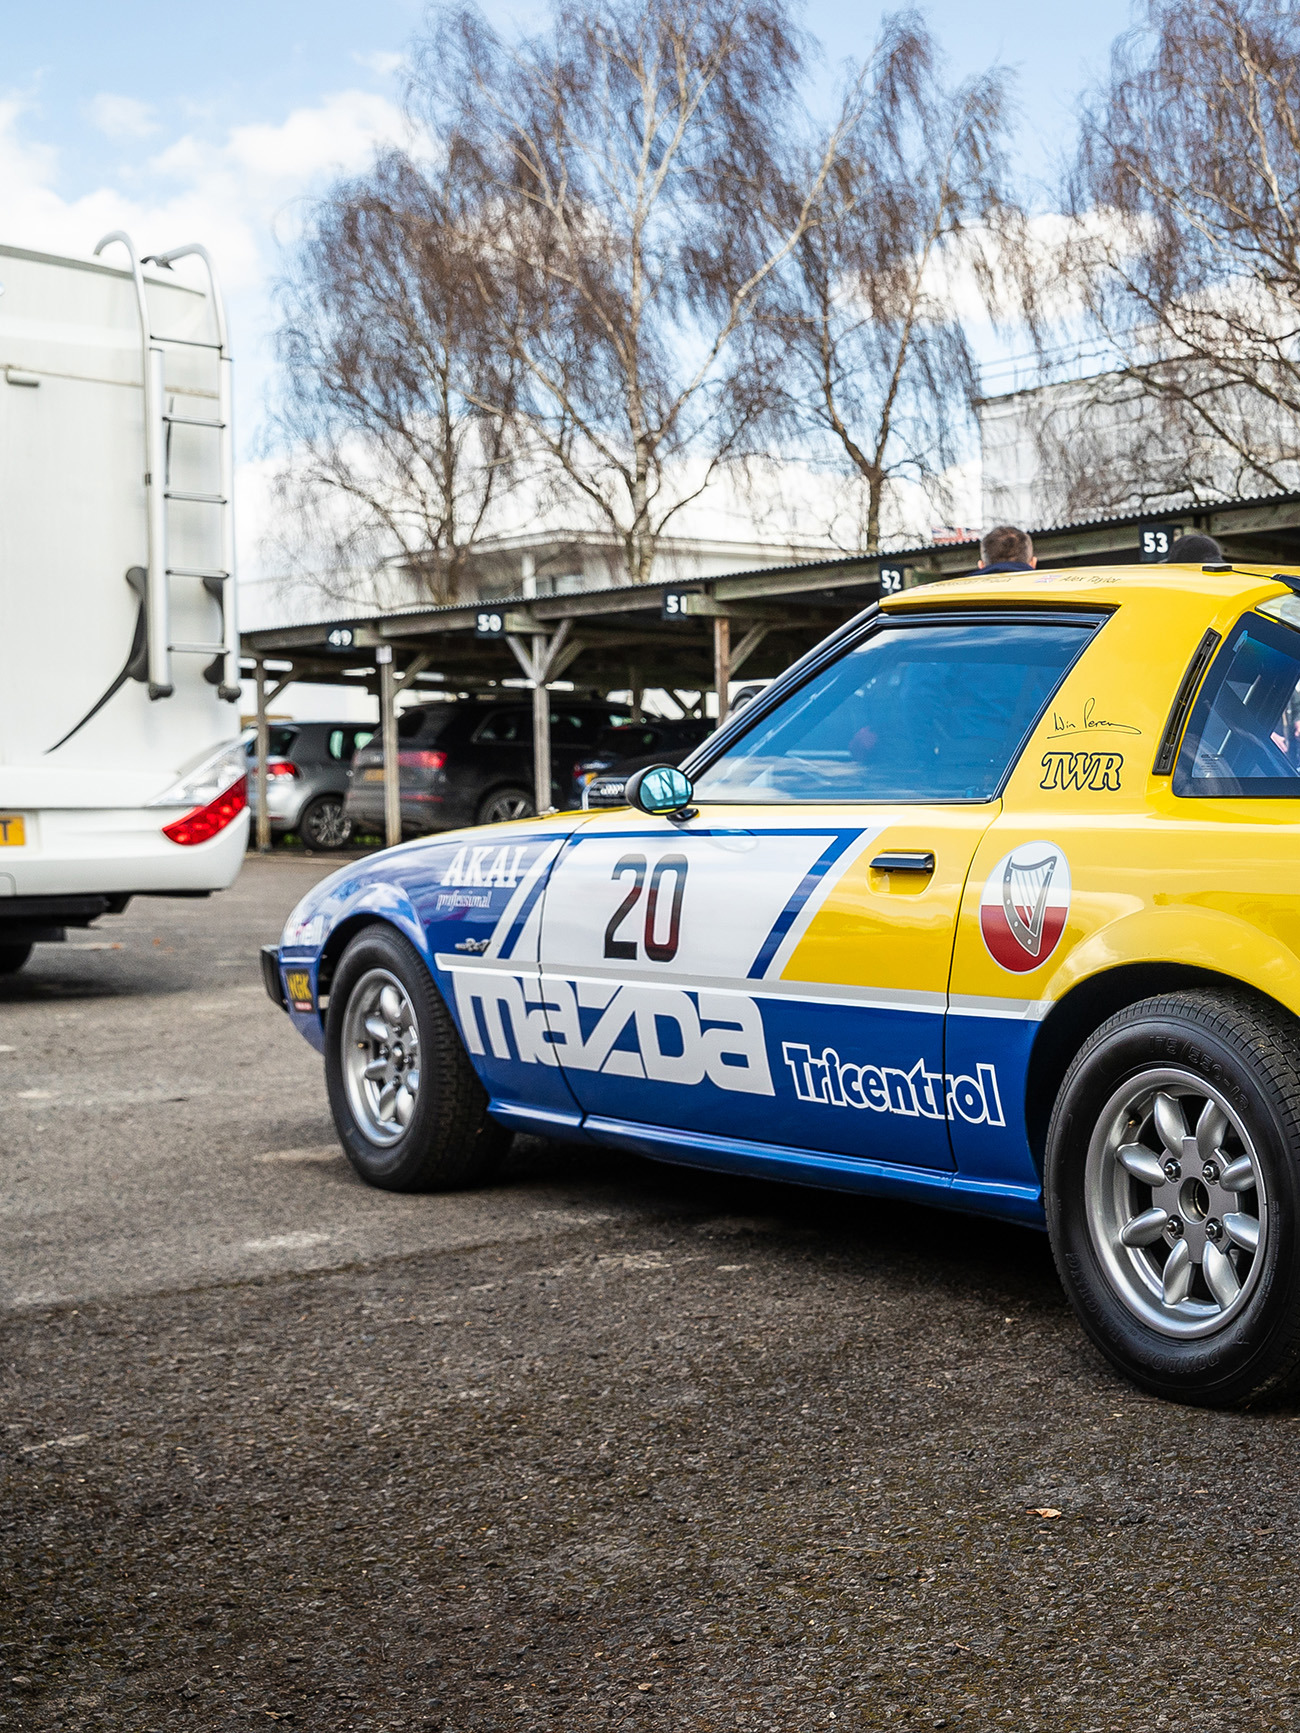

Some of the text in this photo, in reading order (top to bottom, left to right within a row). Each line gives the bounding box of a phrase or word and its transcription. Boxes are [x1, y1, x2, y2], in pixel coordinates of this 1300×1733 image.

[1143, 531, 1169, 554] 53
[881, 569, 902, 590] 52
[666, 594, 688, 614] 51
[477, 613, 502, 632] 50
[1040, 751, 1124, 792] TWR
[440, 845, 528, 888] AKAI
[435, 890, 493, 911] professional
[603, 853, 689, 963] 20
[781, 1041, 1007, 1128] Tricentrol
